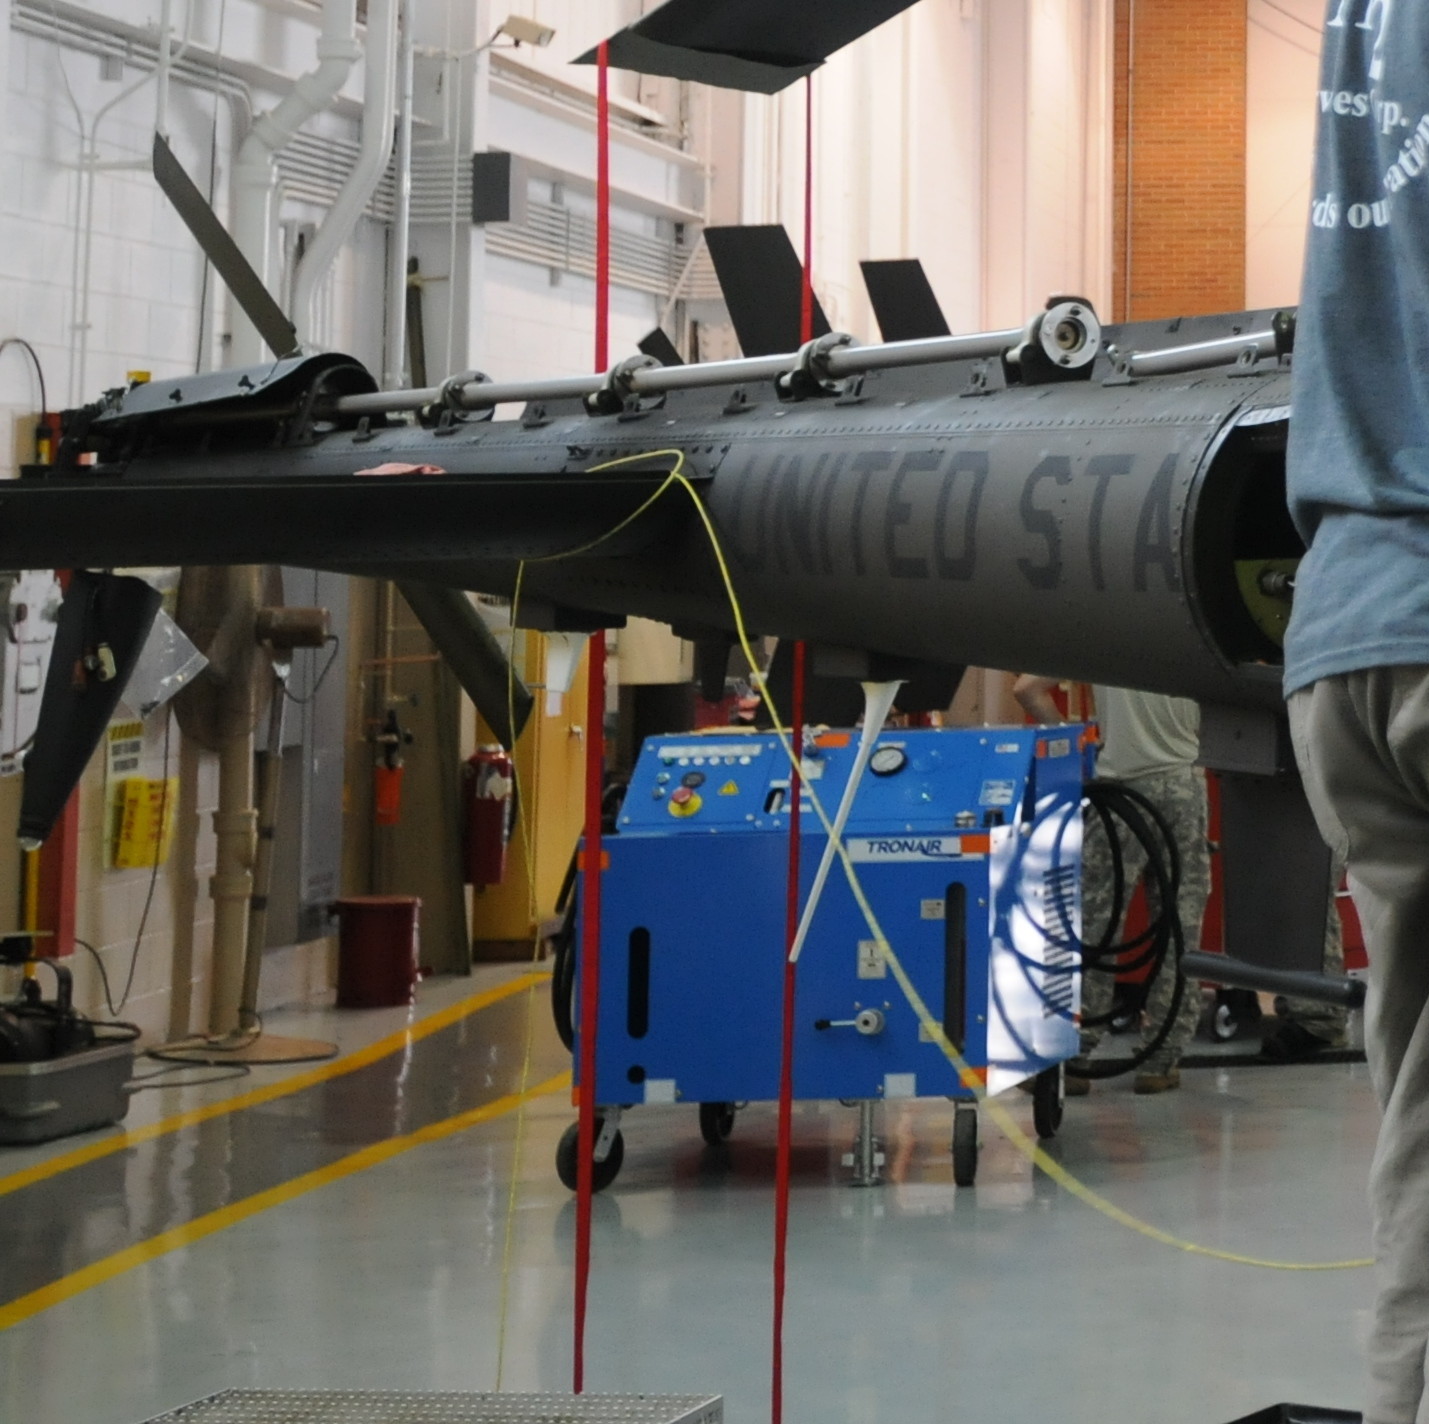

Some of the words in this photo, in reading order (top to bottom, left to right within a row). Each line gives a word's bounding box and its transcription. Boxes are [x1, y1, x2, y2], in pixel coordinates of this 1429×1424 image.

[1347, 198, 1391, 229] ou
[730, 449, 990, 581] UNITED
[1016, 452, 1184, 593] STA
[867, 839, 942, 854] TRONAIR
